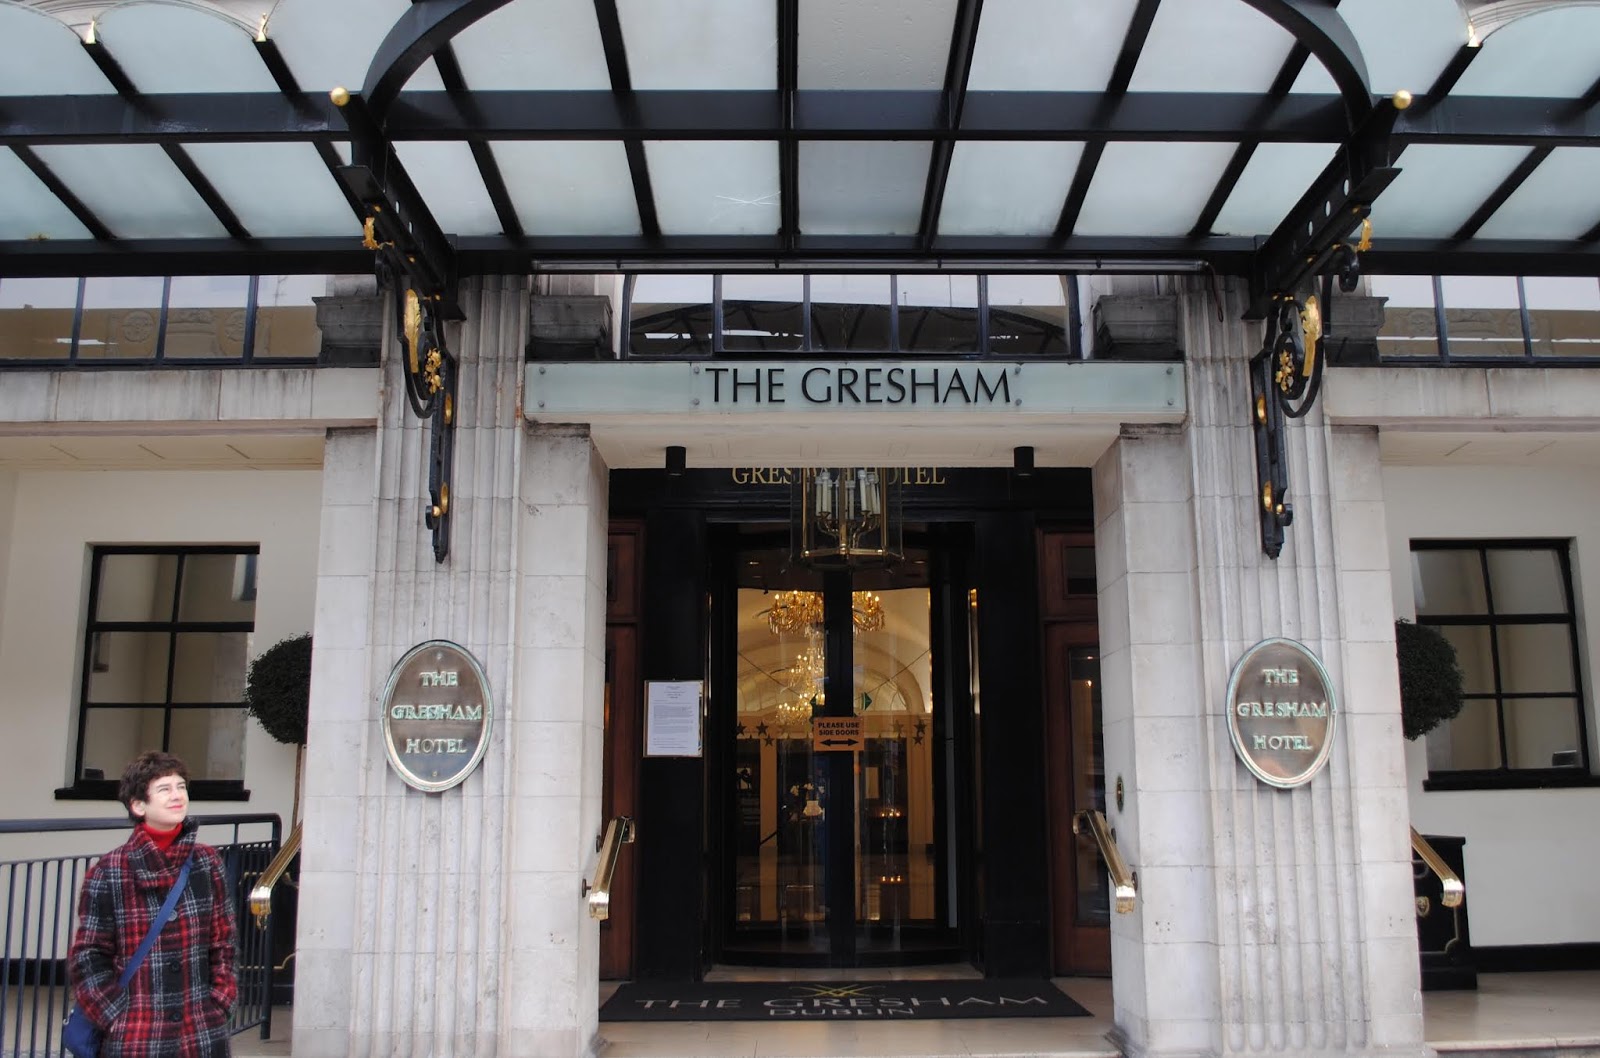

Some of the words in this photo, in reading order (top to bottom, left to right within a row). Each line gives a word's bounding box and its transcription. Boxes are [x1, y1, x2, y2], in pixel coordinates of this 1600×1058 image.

[705, 367, 786, 403] THE
[801, 366, 1011, 404] GRESHAM
[419, 671, 459, 687] THE
[1262, 668, 1299, 685] THE
[391, 704, 482, 720] GRESHAM
[1237, 702, 1327, 717] GRESHAM
[405, 738, 468, 754] HOTEL
[1253, 735, 1314, 750] HOTEL
[635, 999, 742, 1008] THE
[763, 996, 1048, 1008] GRESHAM
[769, 1007, 915, 1016] DUBLIN
